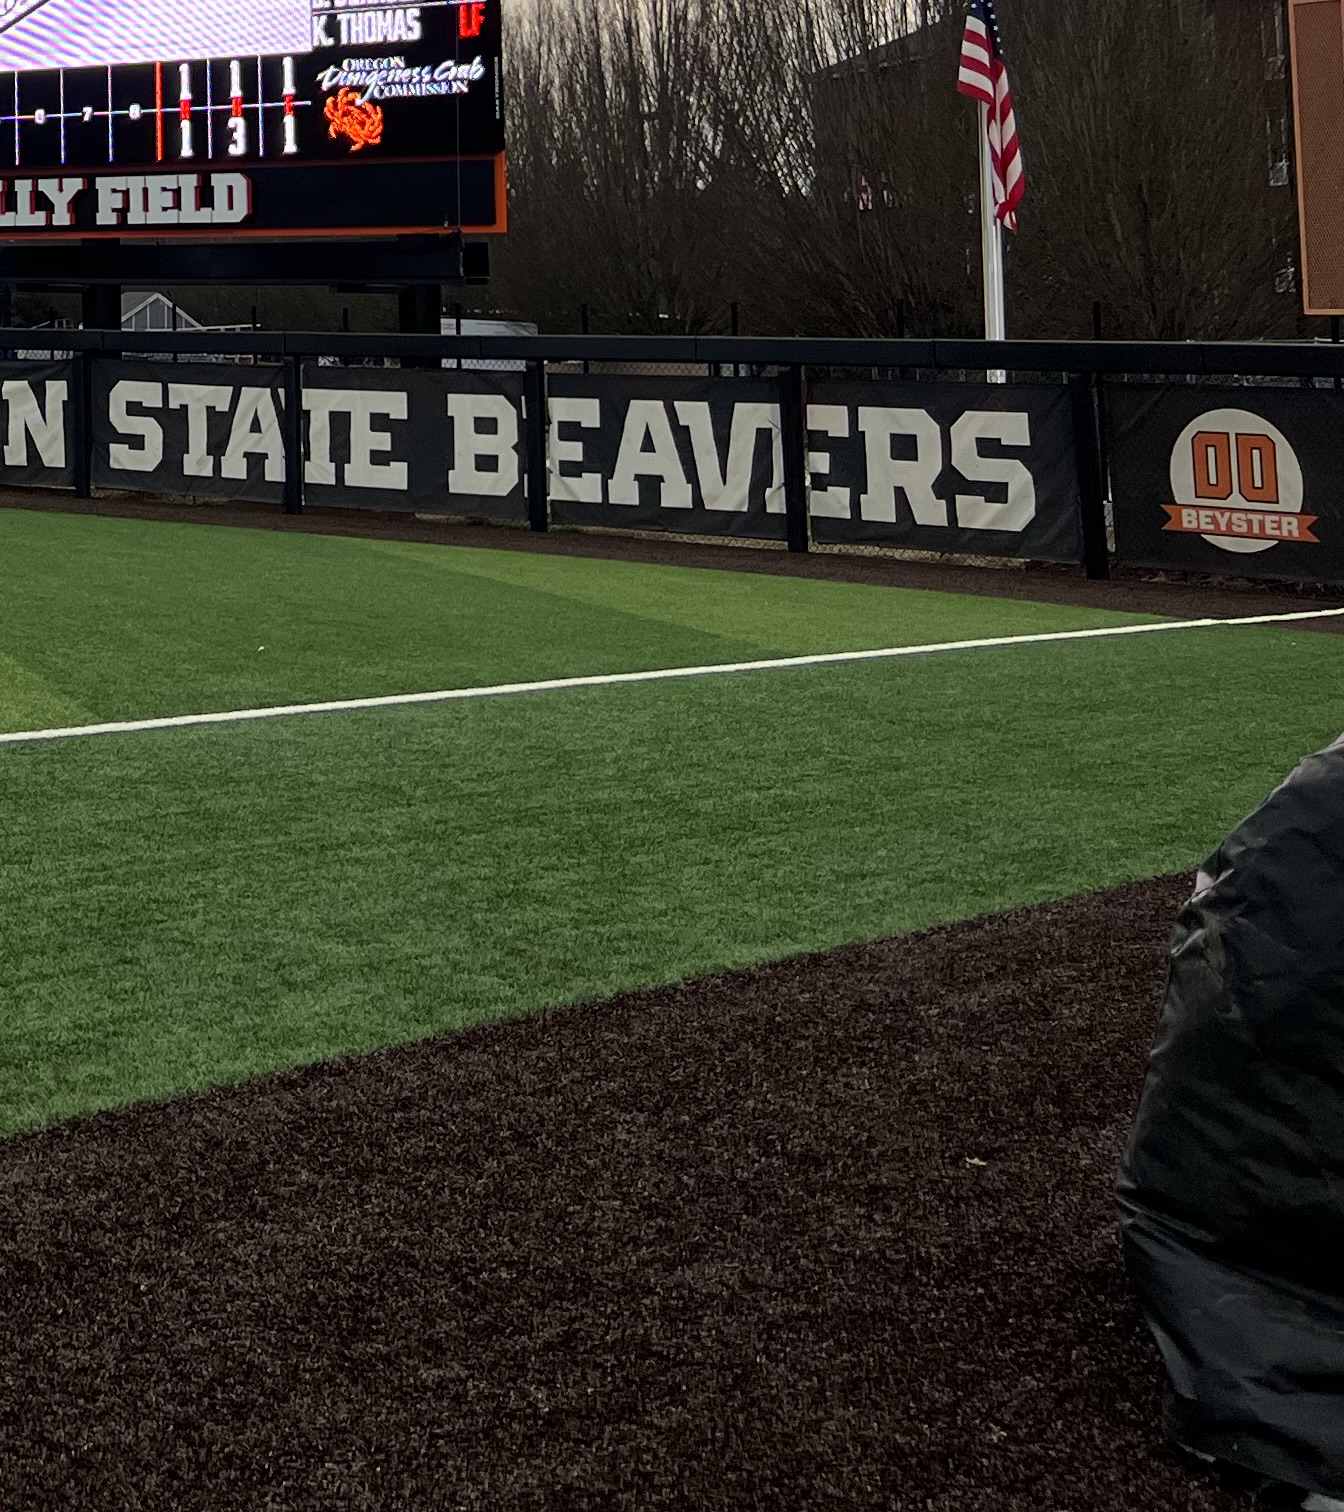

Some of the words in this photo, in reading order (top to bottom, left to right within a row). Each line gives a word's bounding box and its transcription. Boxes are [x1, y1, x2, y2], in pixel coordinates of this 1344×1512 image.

[312, 15, 334, 46] K.
[337, 8, 421, 45] THOMAS
[179, 63, 192, 100] 1
[229, 60, 243, 98] 1
[282, 56, 296, 95] 1
[342, 56, 405, 71] OREGON
[82, 105, 93, 122] 7
[180, 119, 194, 158] 1
[227, 116, 246, 156] 3
[282, 115, 298, 155] 1
[96, 172, 252, 226] FIELD
[109, 380, 408, 490] STATE
[446, 393, 1036, 532] BEAVERS
[1191, 431, 1279, 504] 00
[1181, 508, 1300, 538] BEYSTER
